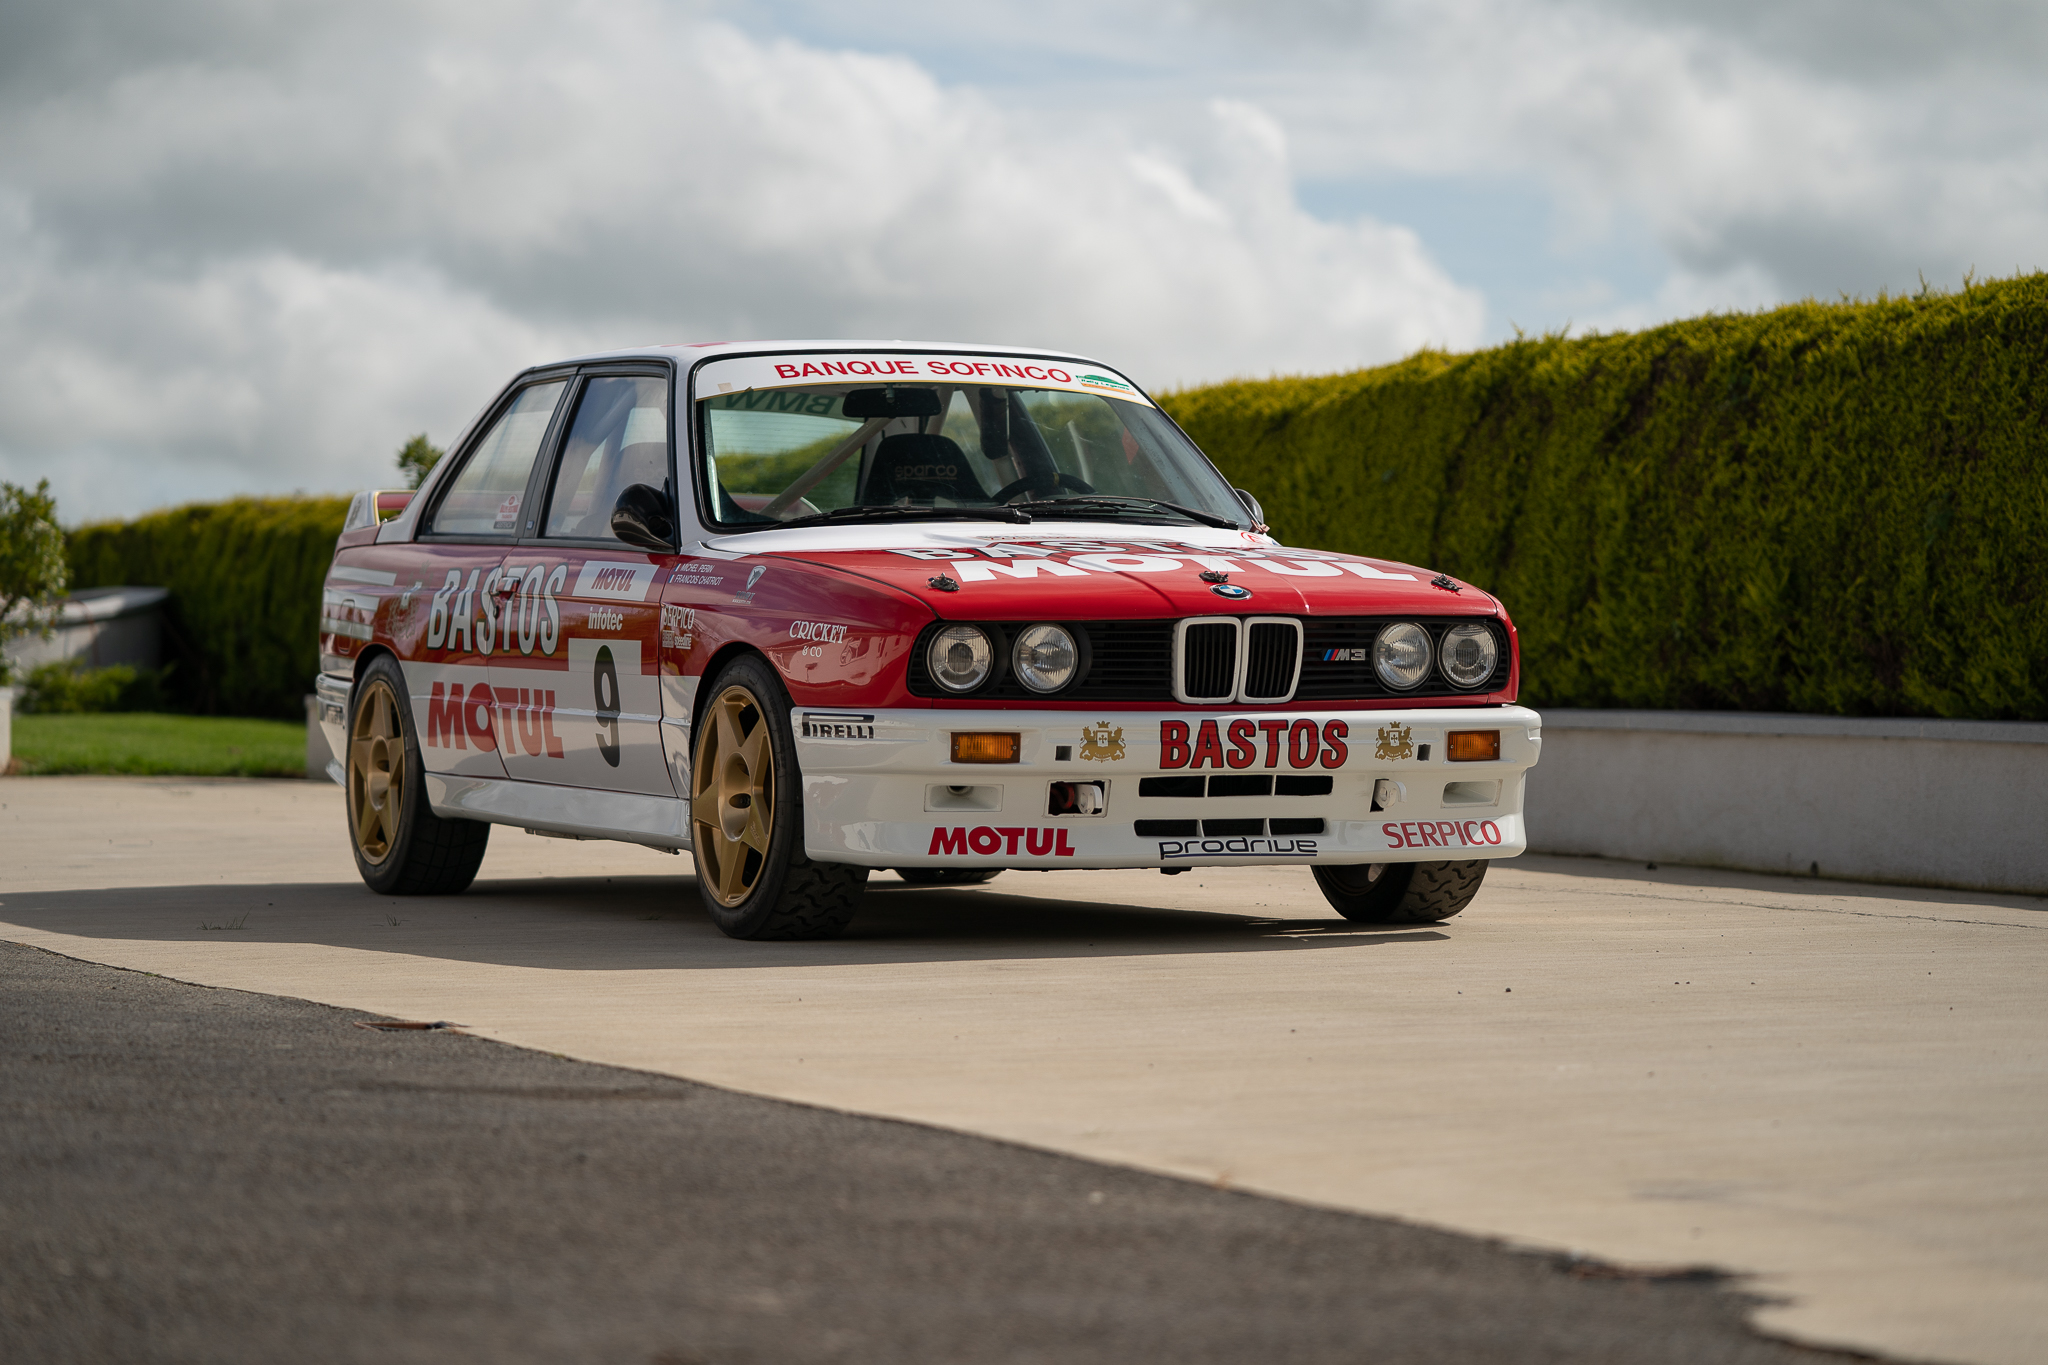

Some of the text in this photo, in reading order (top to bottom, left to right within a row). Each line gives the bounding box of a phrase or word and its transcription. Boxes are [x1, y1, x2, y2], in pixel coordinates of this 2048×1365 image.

[774, 360, 1073, 383] BANQUE SOFINCO
[591, 567, 637, 592] MOTUL
[950, 553, 1419, 582] MOTUL
[426, 562, 569, 657] BASTOS
[588, 607, 623, 631] infotec
[663, 604, 695, 629] SERPICO
[789, 620, 848, 644] CRICKET
[810, 646, 822, 657] CO
[593, 644, 621, 768] 9
[427, 681, 565, 759] MOTUL
[802, 712, 875, 739] PIRELLI
[1159, 718, 1350, 770] BASTOS
[928, 826, 1076, 857] MOTUL
[1381, 820, 1502, 849] SERPICO
[1158, 837, 1319, 860] prodrive
